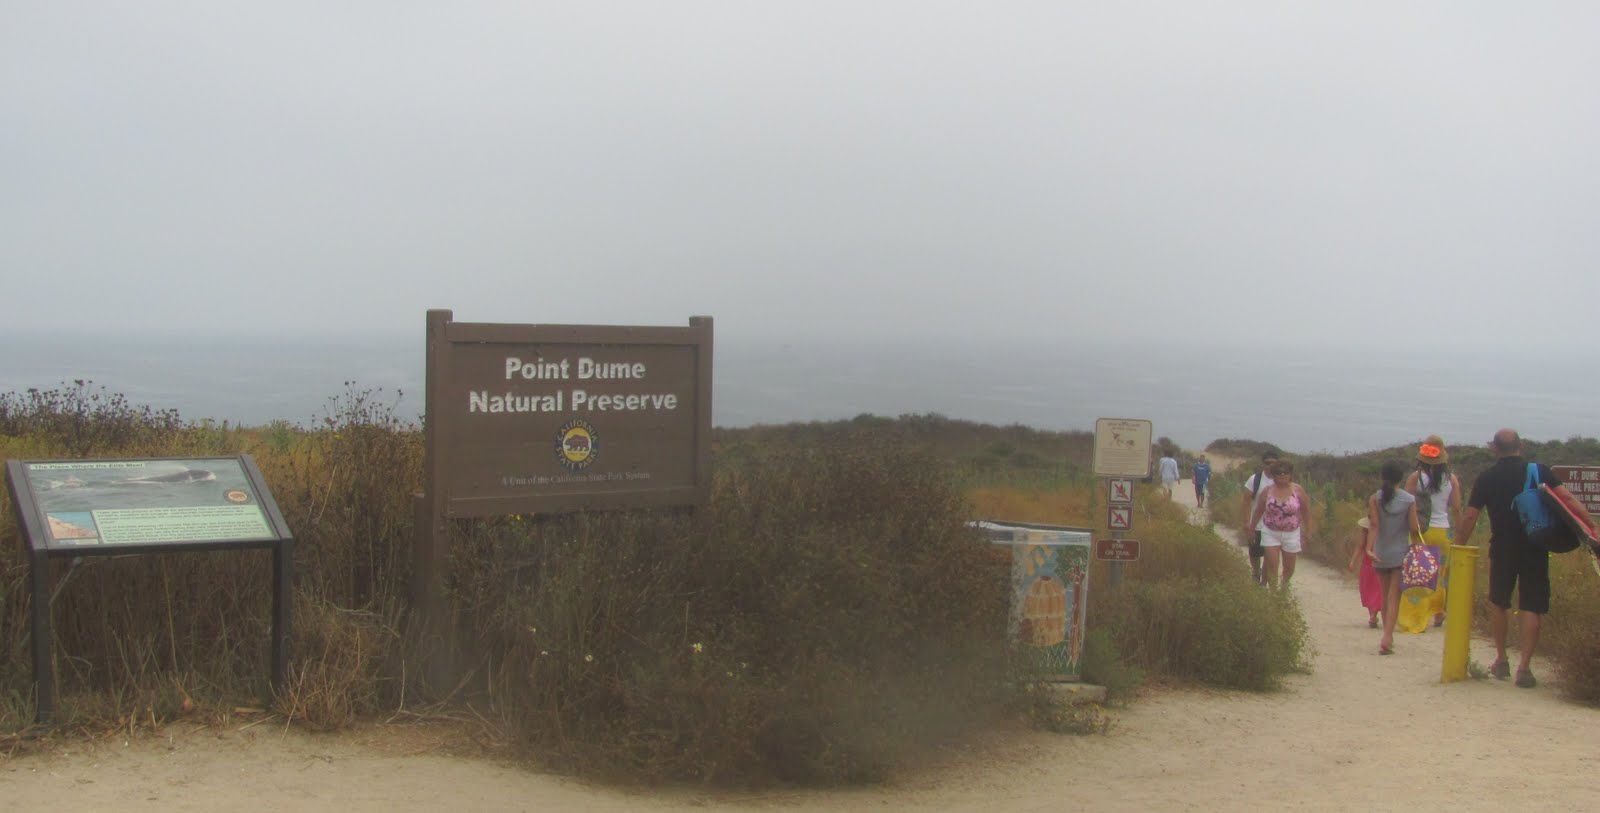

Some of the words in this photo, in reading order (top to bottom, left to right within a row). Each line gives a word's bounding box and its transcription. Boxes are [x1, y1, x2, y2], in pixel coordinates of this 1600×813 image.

[505, 357, 570, 380] Point
[577, 357, 646, 379] Dume
[469, 390, 563, 413] Natural
[571, 390, 677, 411] Preserve
[556, 419, 598, 442] CALIFORNIA
[556, 447, 576, 470] STATE
[578, 448, 598, 469] PARKS
[510, 475, 526, 485] Unit
[528, 475, 537, 485] of
[537, 475, 550, 484] the
[550, 474, 588, 483] California
[589, 473, 607, 482] State
[607, 472, 623, 480] Park
[625, 471, 650, 481] System
[1569, 470, 1580, 480] PT.
[1581, 470, 1600, 481] DUME
[1583, 482, 1600, 492] PRES
